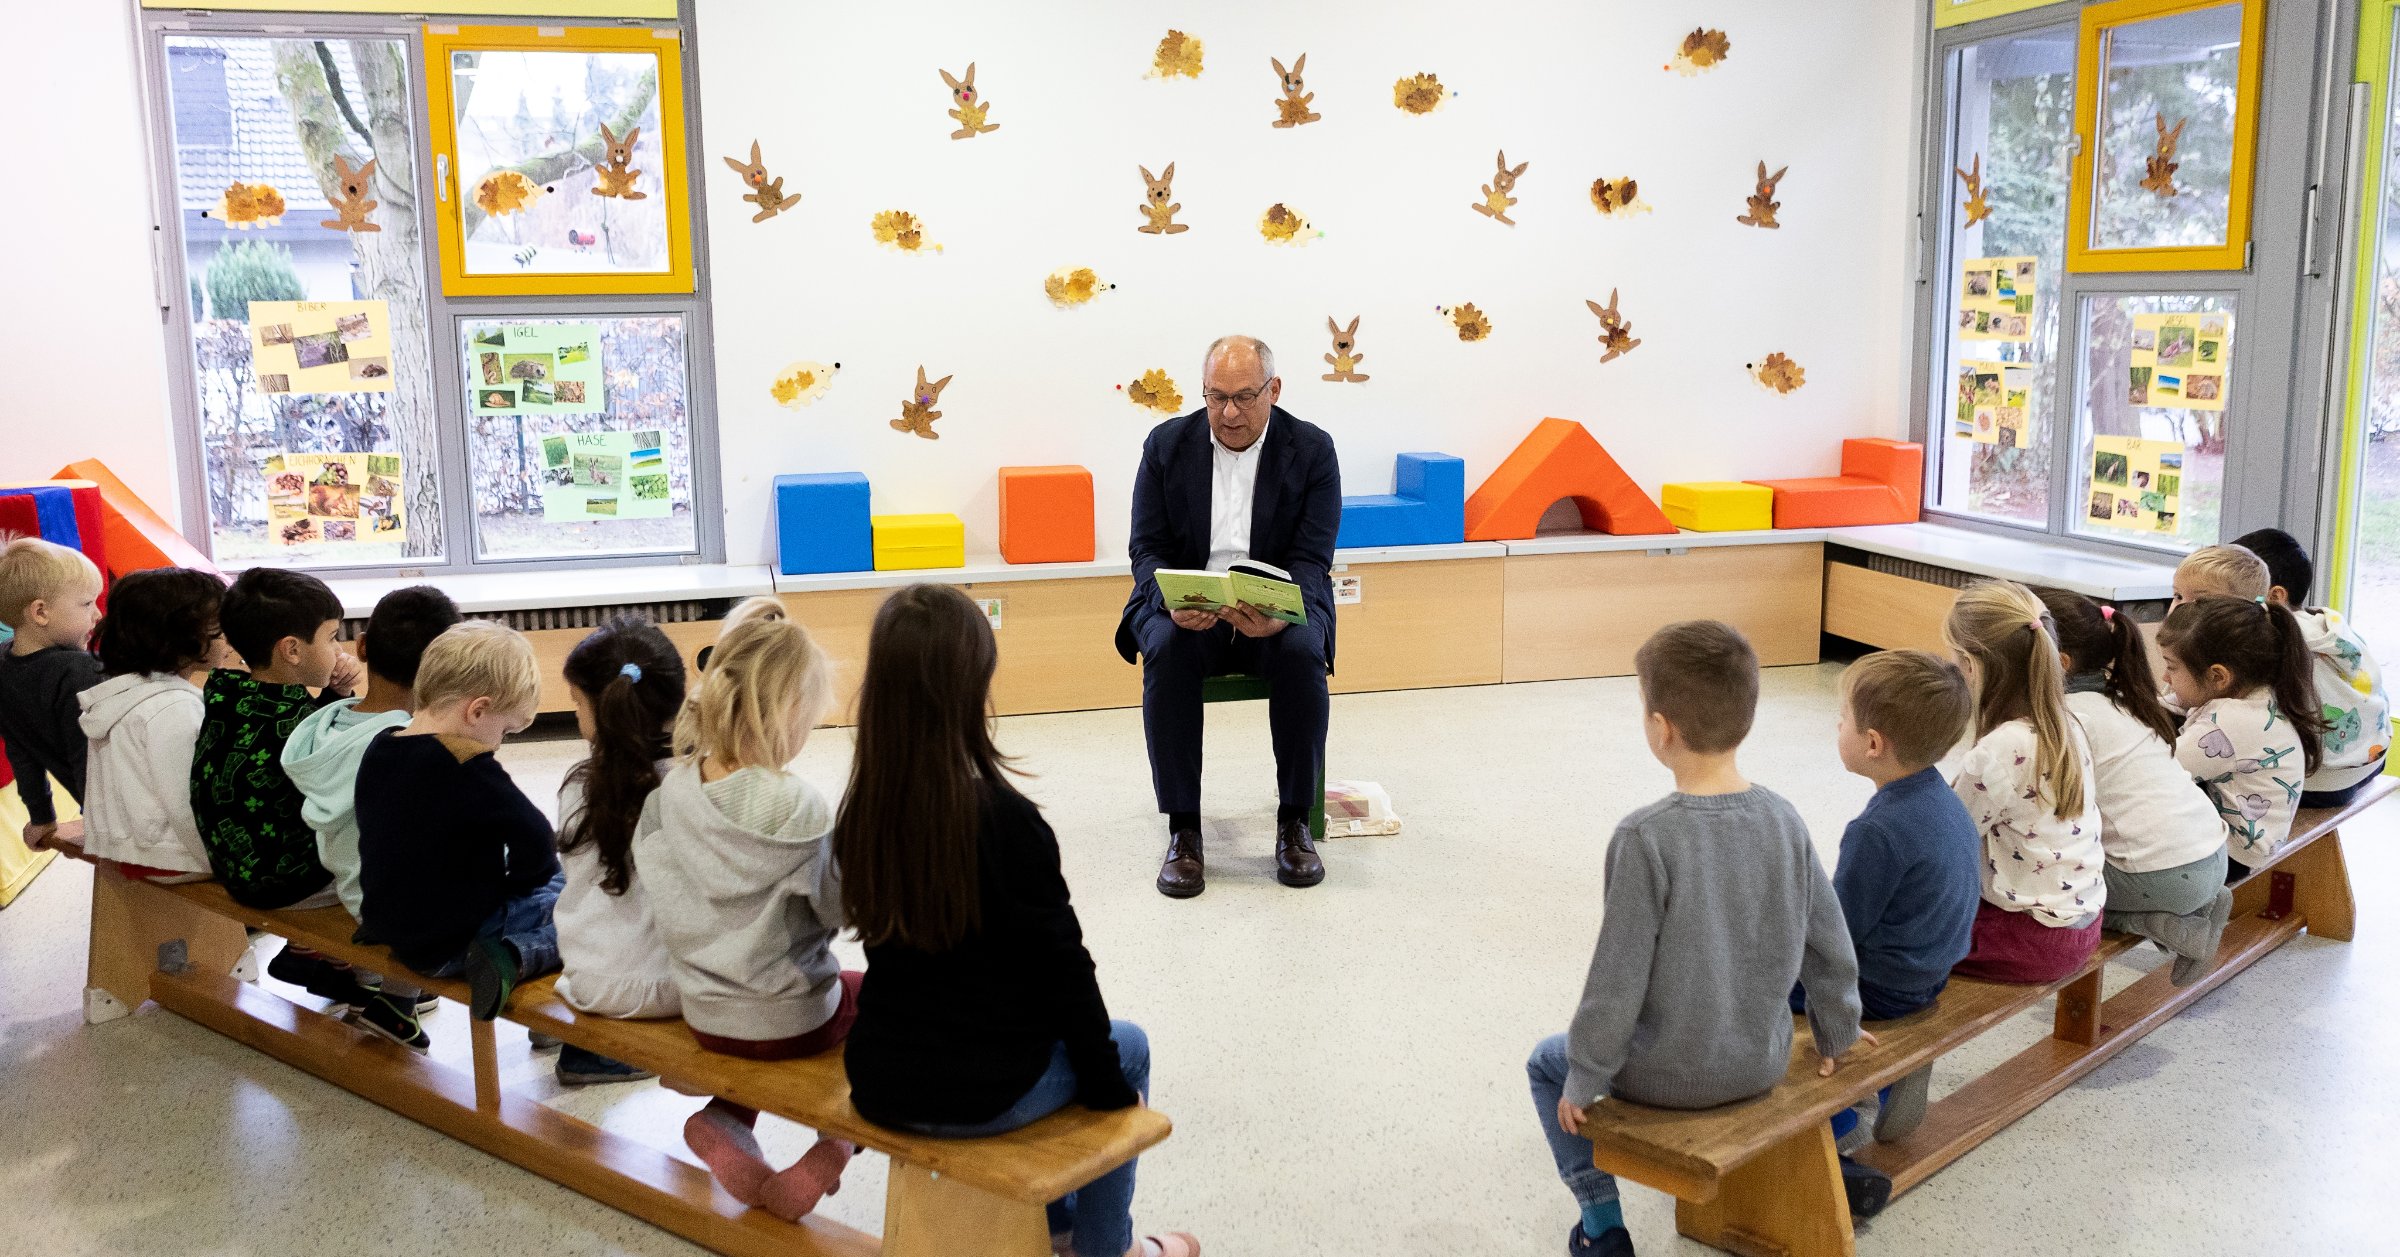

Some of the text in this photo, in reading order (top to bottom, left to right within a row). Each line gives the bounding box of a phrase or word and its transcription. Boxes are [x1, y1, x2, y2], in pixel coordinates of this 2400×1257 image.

[296, 301, 328, 312] BIBER
[513, 326, 539, 338] IGEL
[577, 434, 607, 446] HASE
